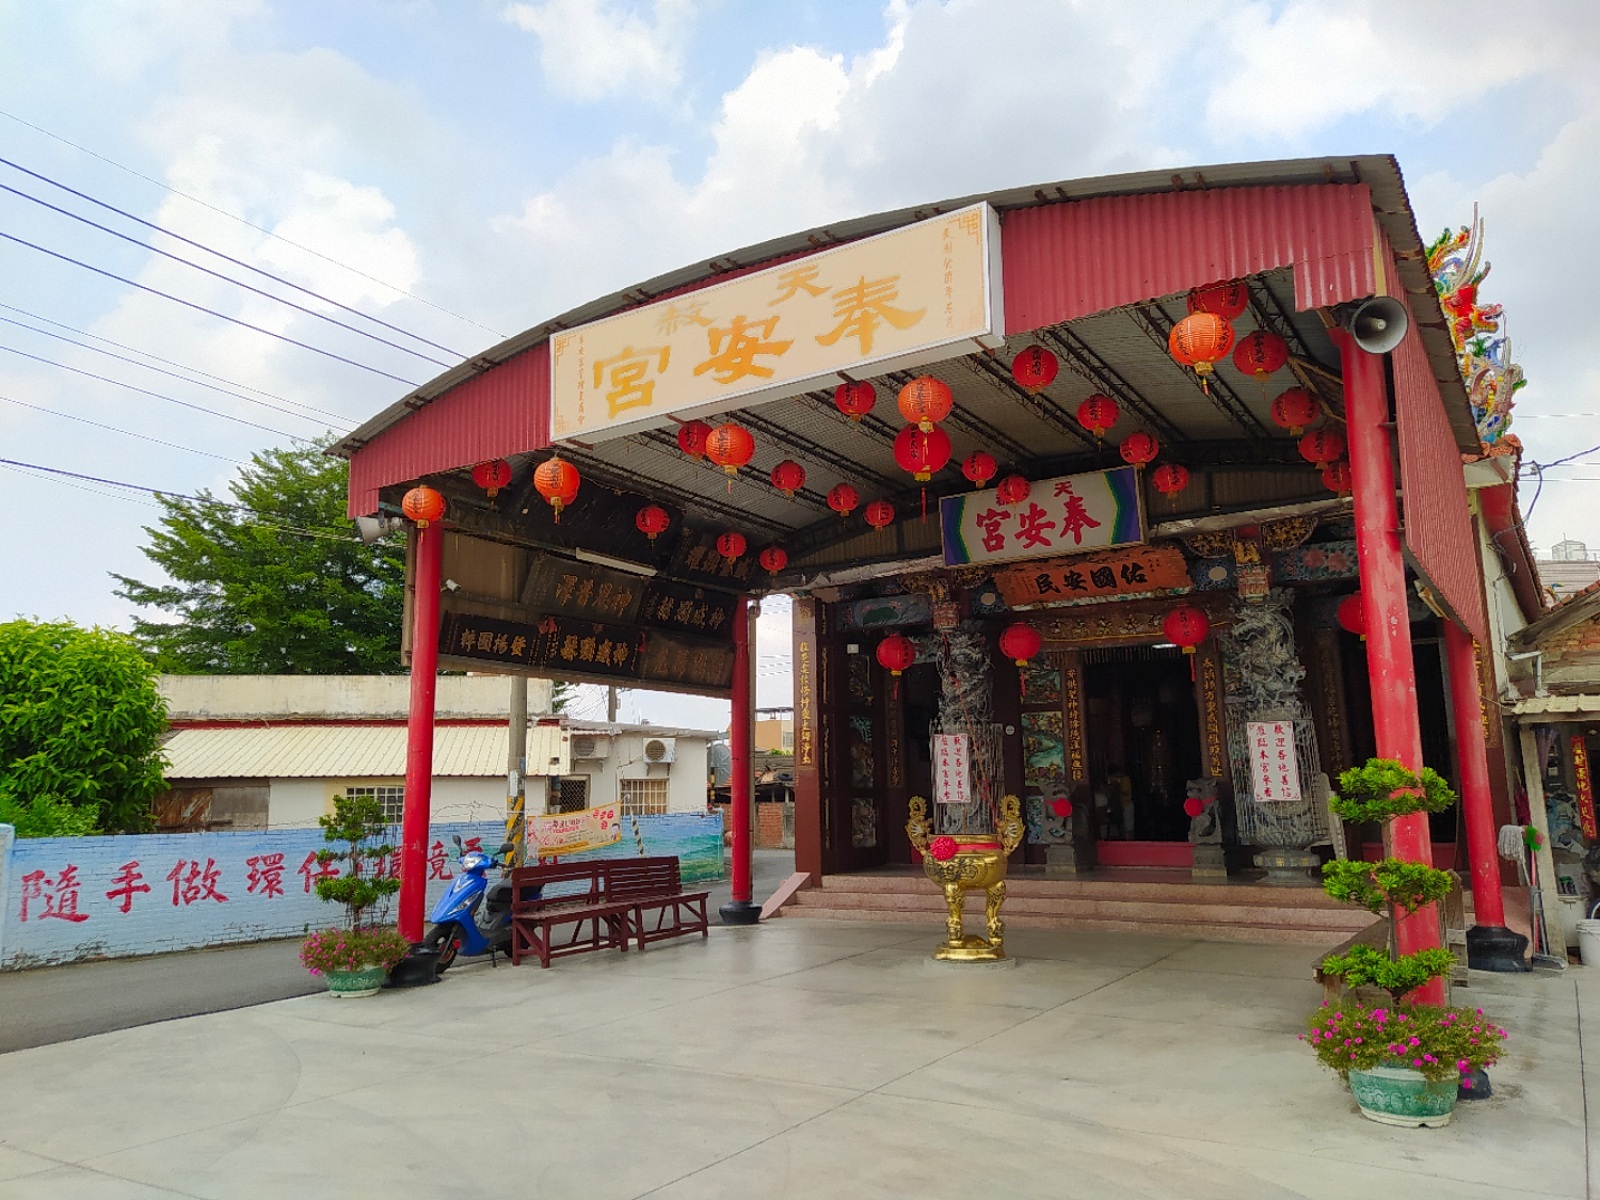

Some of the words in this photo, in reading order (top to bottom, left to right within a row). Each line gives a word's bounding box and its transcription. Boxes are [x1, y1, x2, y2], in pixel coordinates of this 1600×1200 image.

[768, 264, 833, 307] 天
[593, 275, 927, 419] 奉安宮
[1054, 481, 1074, 497] 天
[976, 496, 1101, 553] 奉安宮
[1035, 562, 1149, 595] 佑國安民
